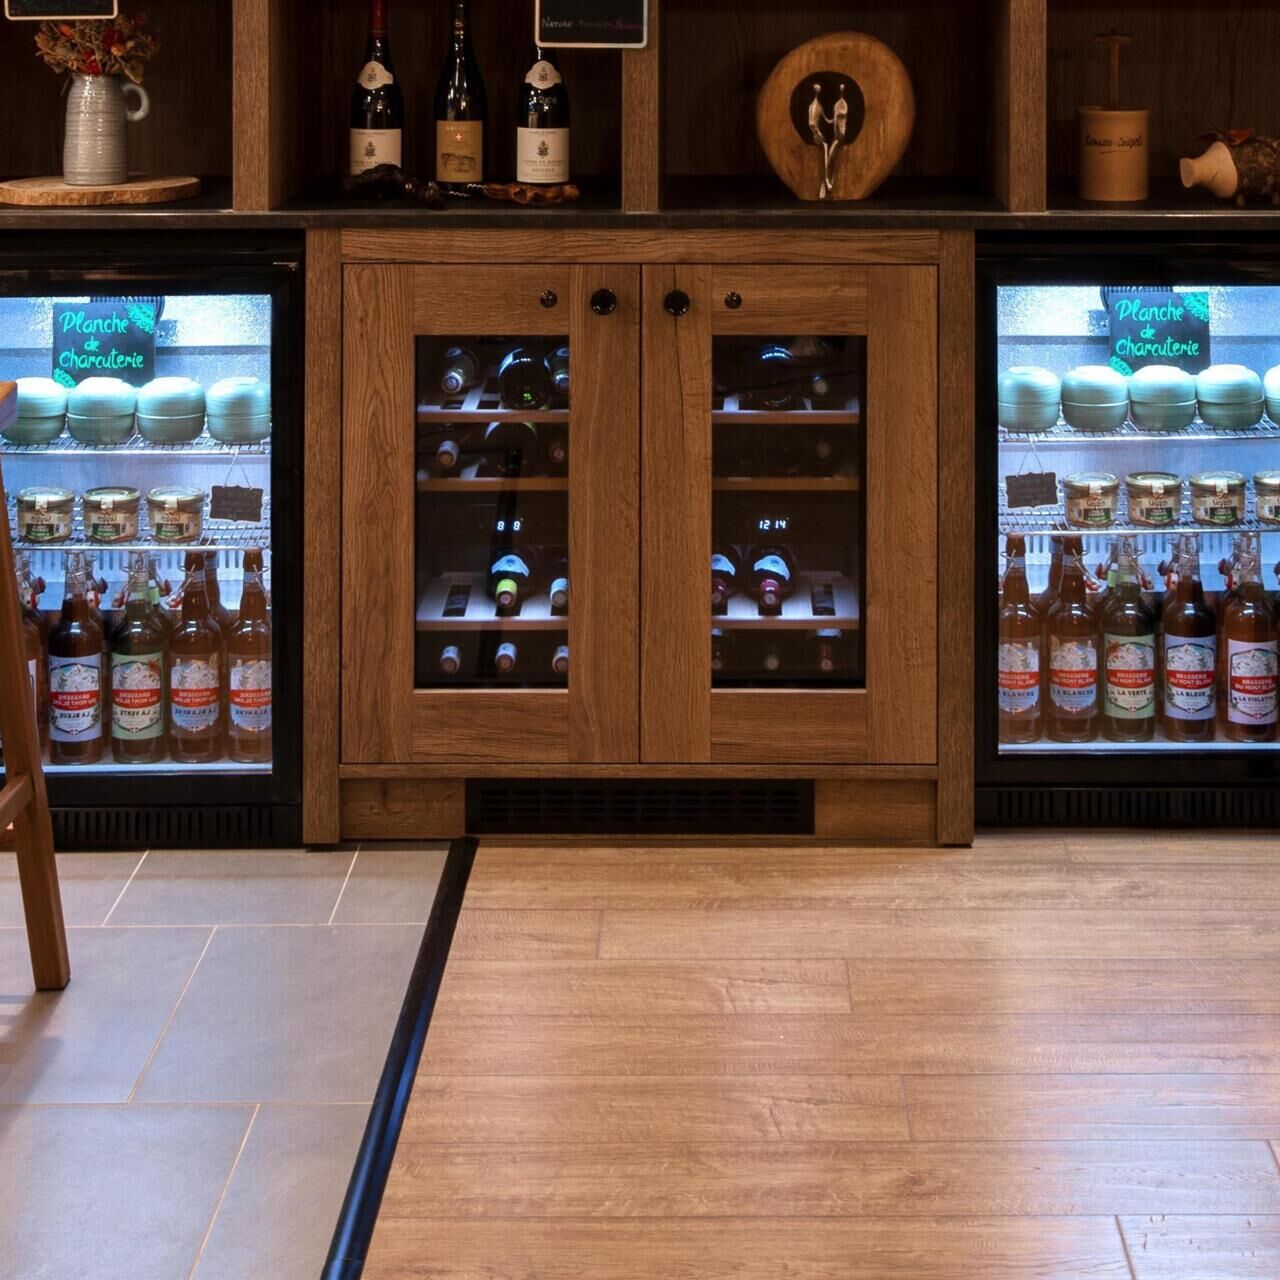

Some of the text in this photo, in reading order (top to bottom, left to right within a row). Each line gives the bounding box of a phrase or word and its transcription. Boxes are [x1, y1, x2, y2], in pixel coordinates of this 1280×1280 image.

[1115, 298, 1185, 323] Planche
[58, 310, 130, 335] Planche
[1140, 324, 1156, 340] de
[84, 336, 101, 351] de
[1115, 338, 1201, 358] Charcuterie
[58, 350, 145, 370] Charcuterie
[497, 520, 505, 531] 8
[759, 519, 771, 530] 12
[1003, 690, 1035, 698] BLANCHE
[1248, 695, 1275, 703] VIOLETTE
